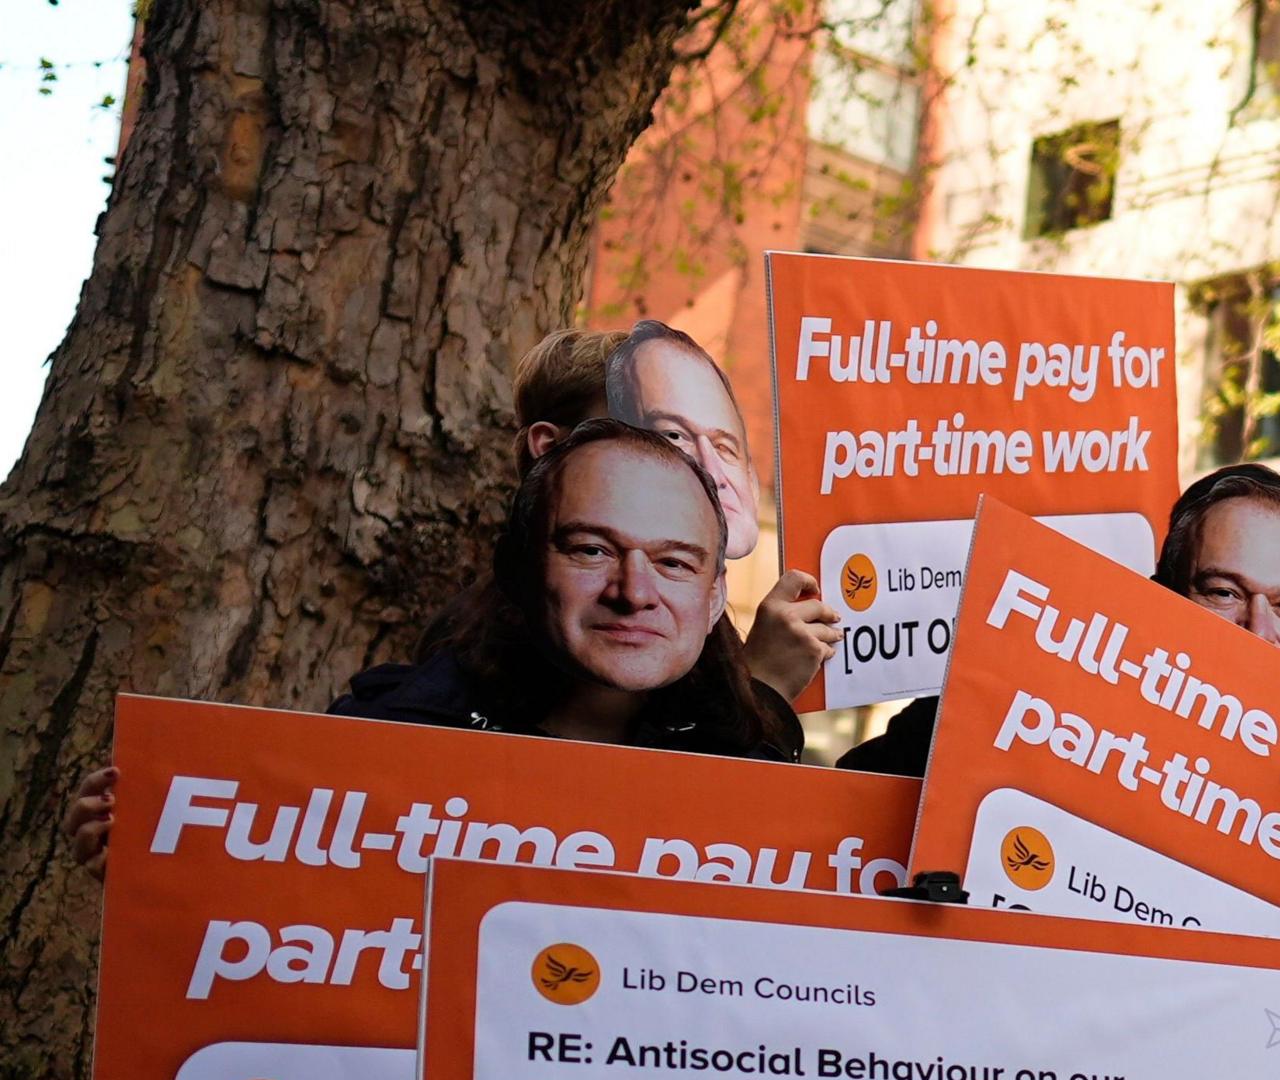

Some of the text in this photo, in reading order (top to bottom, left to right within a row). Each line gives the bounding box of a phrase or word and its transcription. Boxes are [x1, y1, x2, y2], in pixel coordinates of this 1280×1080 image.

[796, 317, 1164, 403] Full-time pay for
[820, 412, 1152, 494] part-time work
[888, 566, 962, 592] Lib Dem
[843, 617, 956, 675] [OUT O
[985, 569, 1277, 757] Full-time
[150, 776, 614, 873] Full-time
[1068, 866, 1106, 902] Lib
[1114, 885, 1173, 925] Dem
[621, 966, 877, 1008] Lib Dem Councils
[527, 1030, 594, 1065] RE:
[604, 1035, 807, 1078] Antisocial
